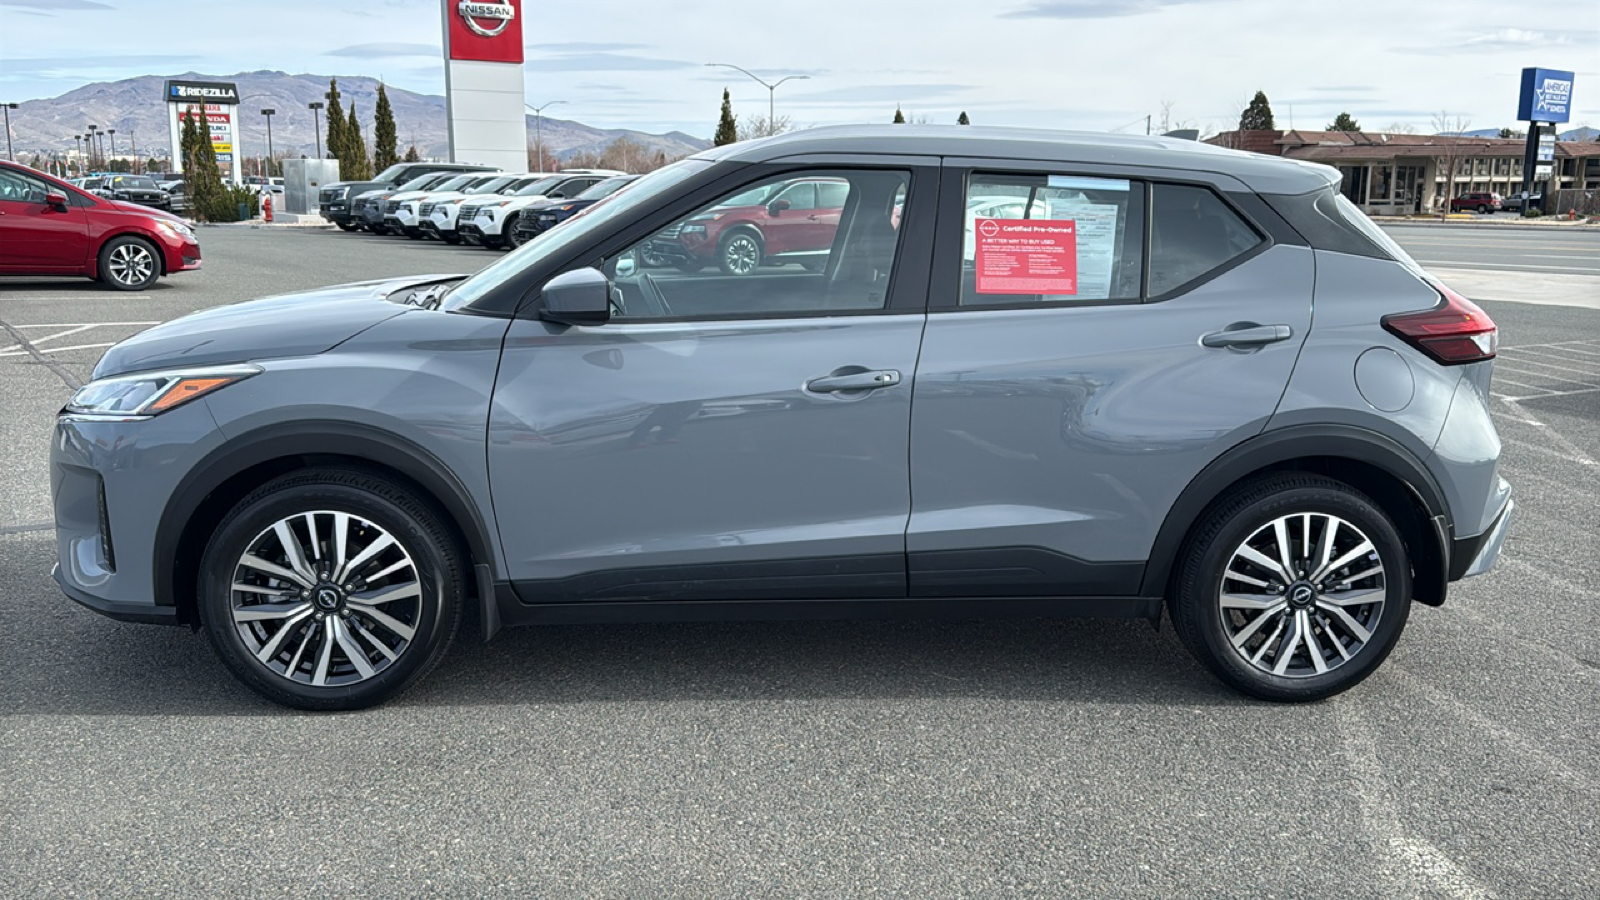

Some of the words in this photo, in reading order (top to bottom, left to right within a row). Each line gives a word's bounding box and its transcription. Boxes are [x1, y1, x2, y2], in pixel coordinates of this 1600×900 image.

[465, 5, 510, 15] NISSAN
[187, 87, 235, 97] RIDEZILLA
[1033, 226, 1072, 234] Pre-Owned
